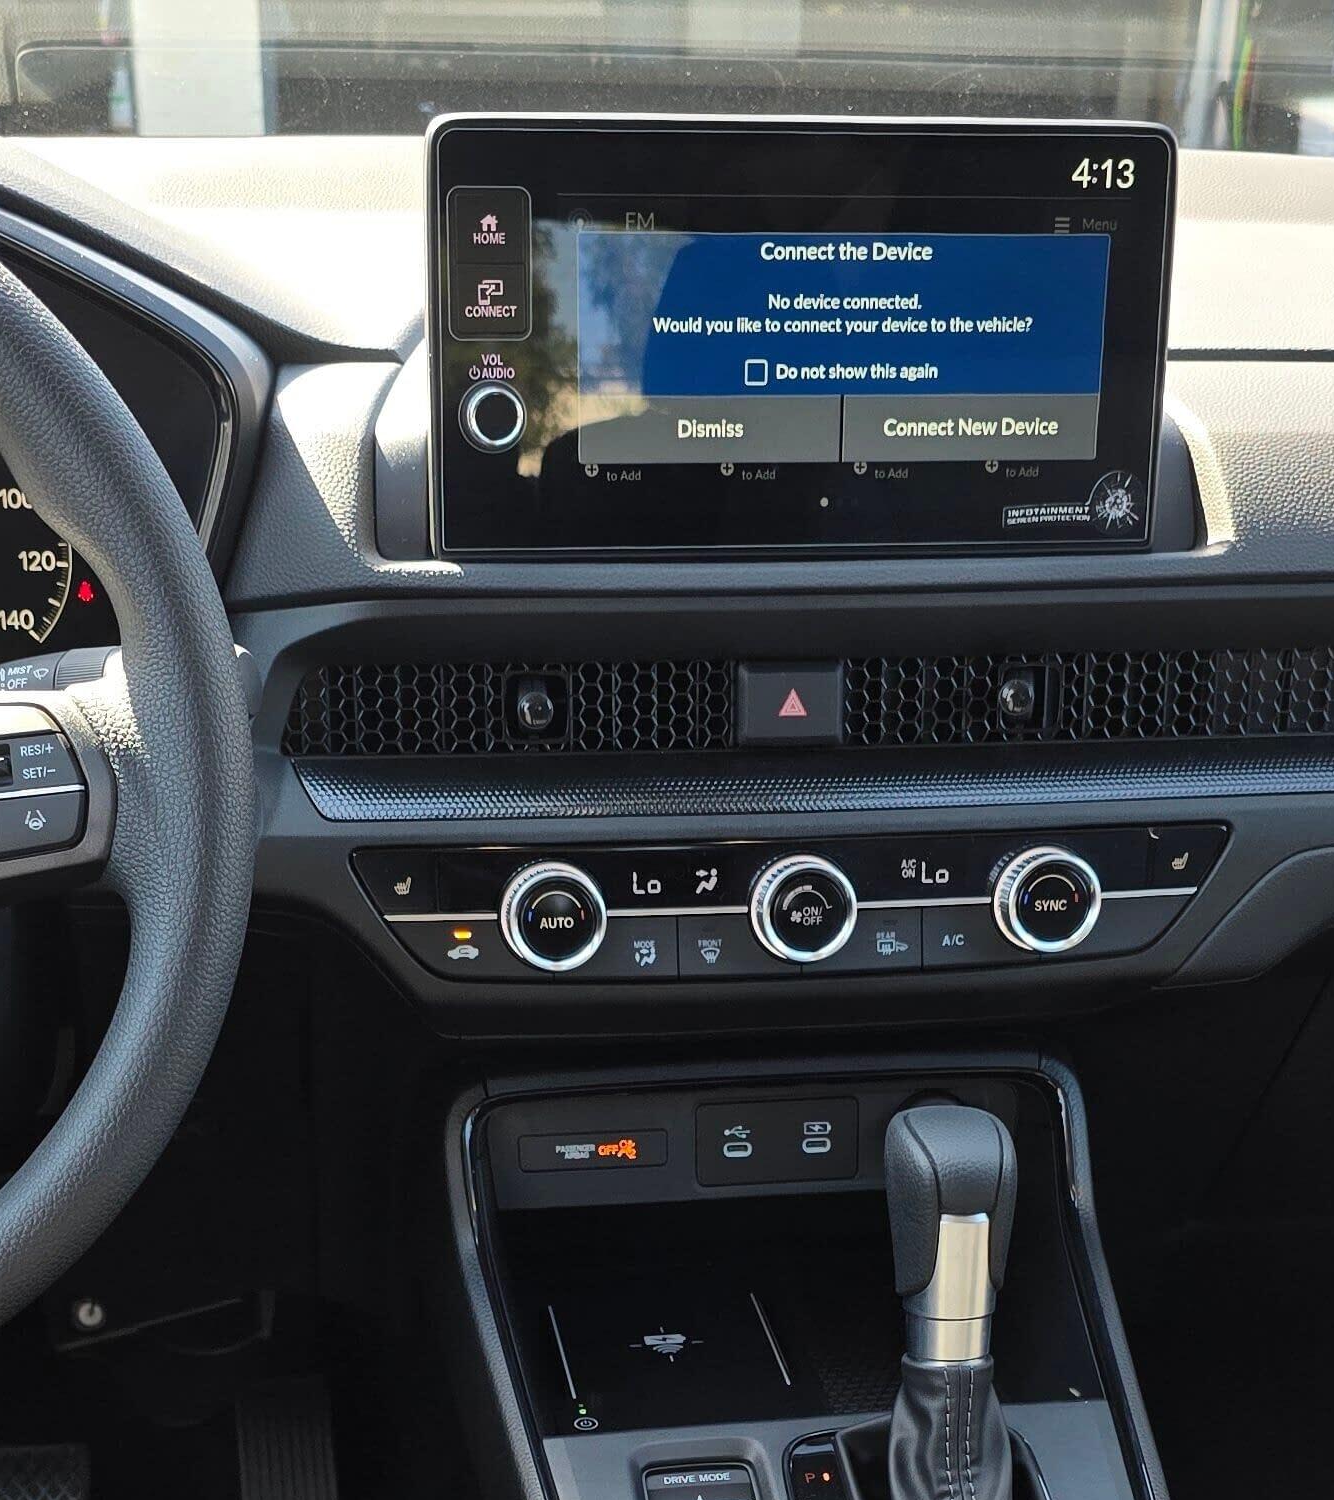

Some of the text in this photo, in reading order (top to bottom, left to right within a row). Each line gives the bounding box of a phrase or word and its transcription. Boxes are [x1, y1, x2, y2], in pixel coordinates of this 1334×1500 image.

[1071, 158, 1135, 189] 4:13
[625, 212, 655, 230] FM
[1082, 217, 1118, 232] Menu
[473, 232, 505, 244] HOME
[760, 242, 933, 261] Connect the Device
[768, 294, 922, 310] No device connected.
[465, 305, 517, 318] CONNECT
[653, 316, 1033, 336] Would you like to connect your device to the vehicle?
[481, 354, 503, 366] VOL
[482, 367, 515, 379] AUDIO
[775, 363, 938, 381] Do not show this again
[677, 419, 744, 438] Dismiss
[883, 417, 1059, 437] Connect New Device
[606, 470, 641, 482] to Add
[742, 469, 776, 481] to Add
[875, 468, 909, 479] to Add
[1005, 466, 1039, 478] to Add
[17, 550, 56, 572] 120
[7, 664, 33, 676] MIST
[7, 678, 28, 690] OFF
[19, 742, 55, 758] RES/+
[901, 858, 917, 869] A/C
[902, 868, 915, 879] ON
[921, 861, 949, 884] Lo
[632, 871, 661, 894] Lo
[1034, 898, 1067, 912] SYNC
[802, 906, 823, 917] ON/
[539, 916, 575, 930] AUTO
[802, 916, 823, 926] OFF
[633, 940, 656, 949] MODE
[697, 938, 722, 948] FRONT
[941, 934, 965, 946] A/C
[597, 1144, 619, 1156] OFF
[663, 1472, 731, 1485] DRIVE MODE
[805, 1472, 815, 1484] P
